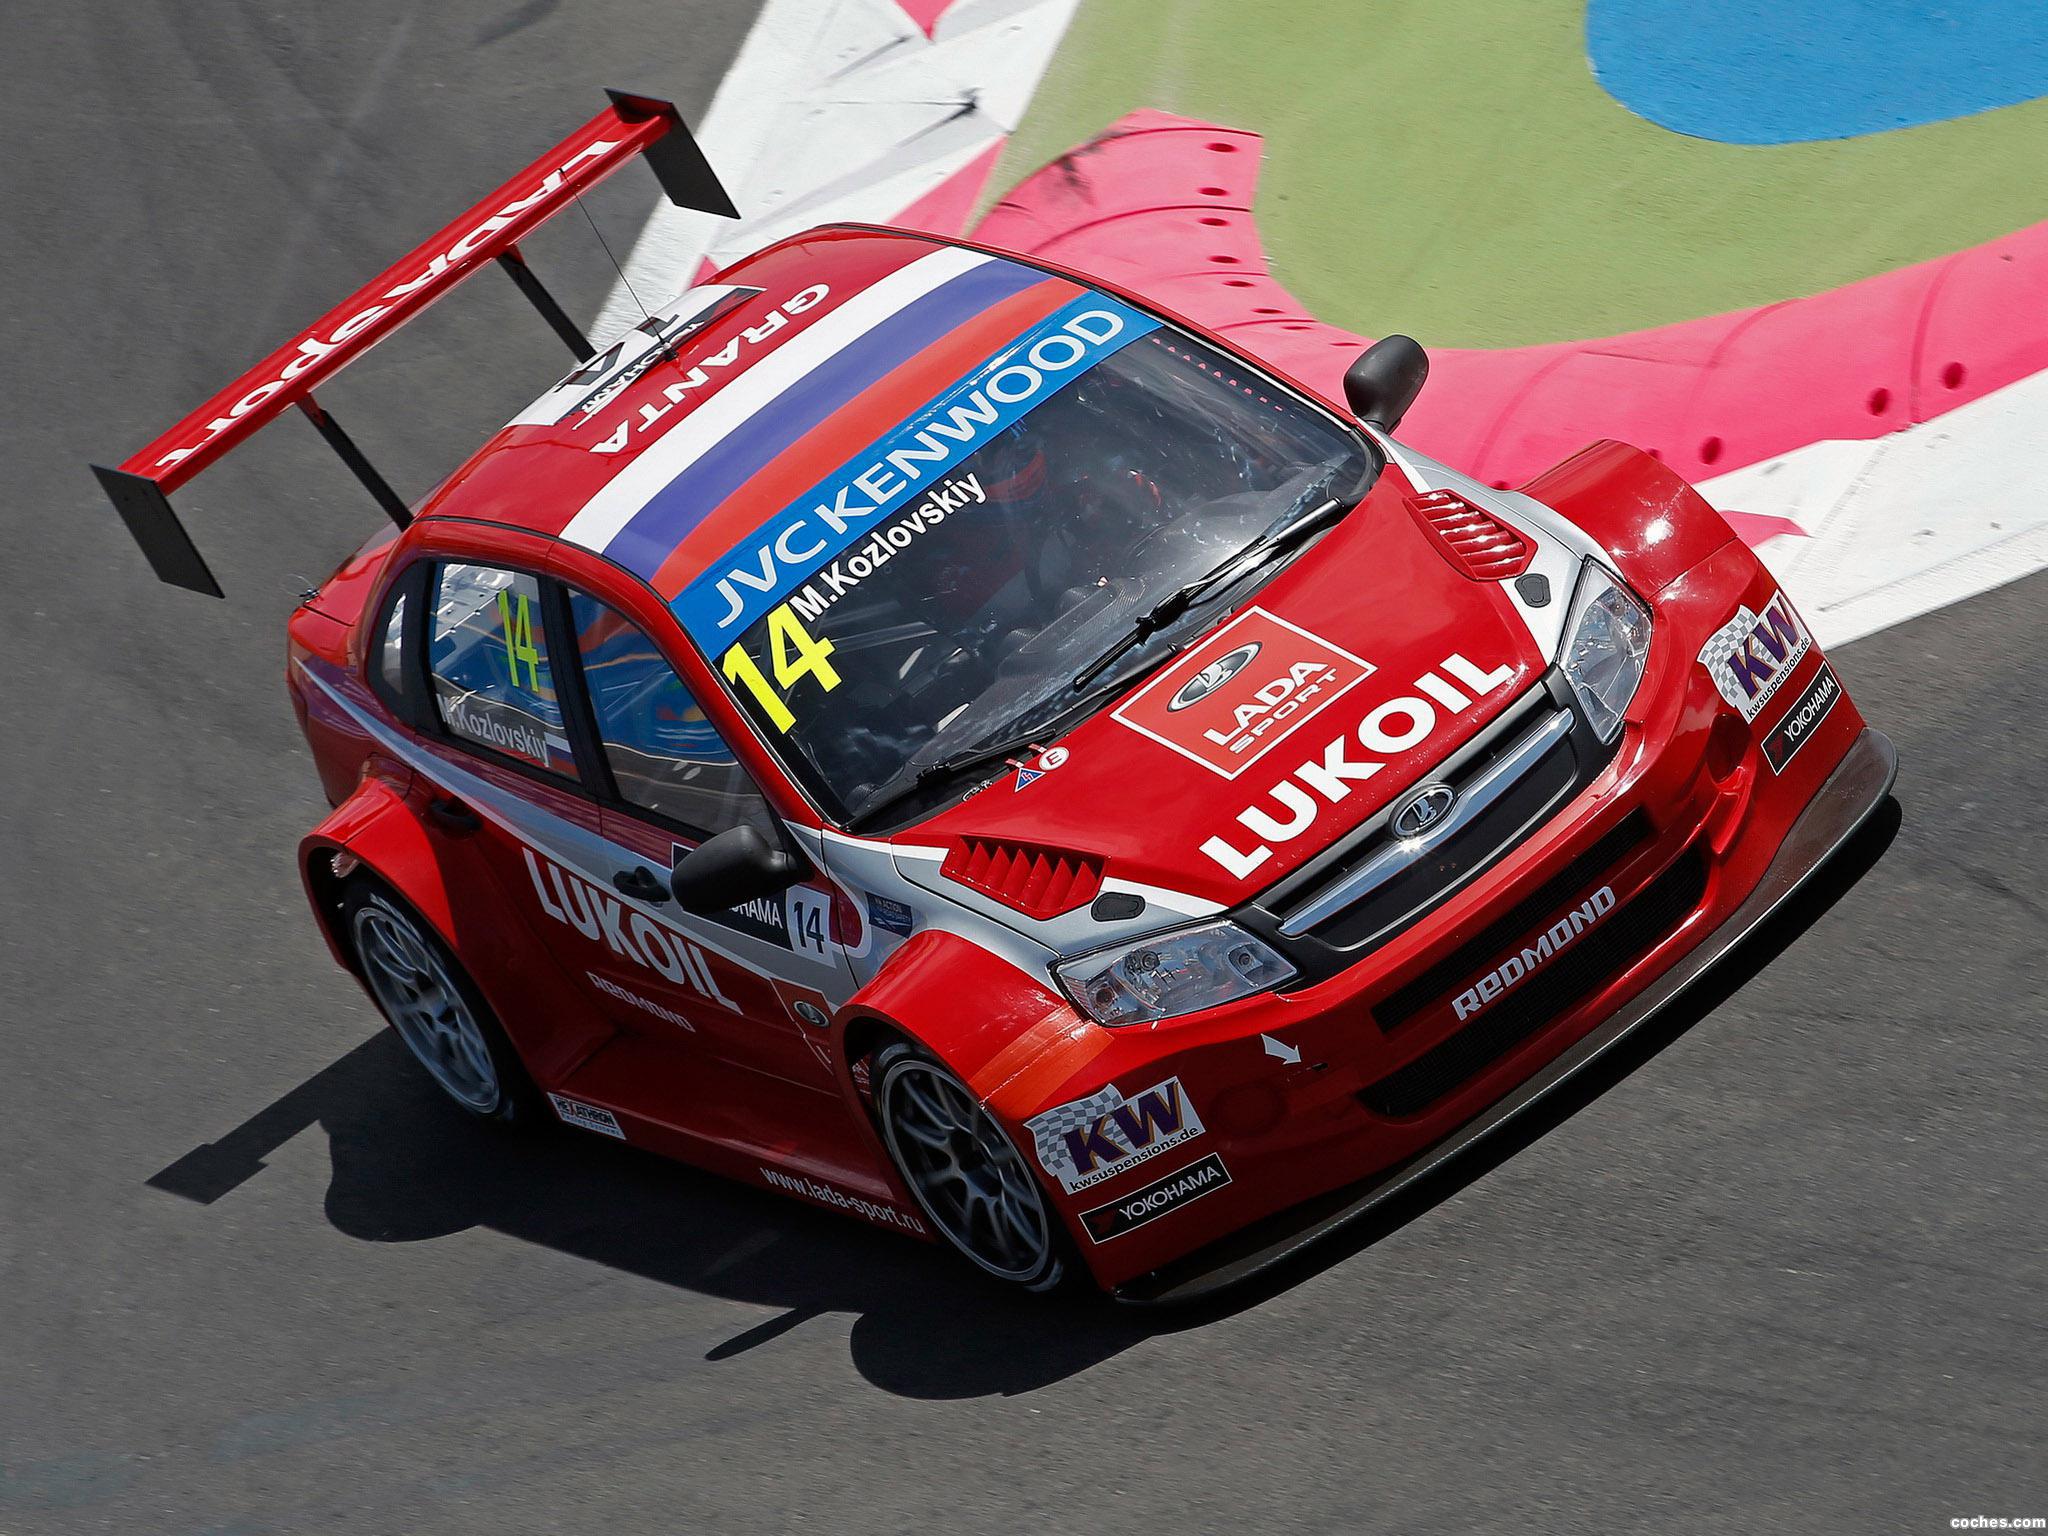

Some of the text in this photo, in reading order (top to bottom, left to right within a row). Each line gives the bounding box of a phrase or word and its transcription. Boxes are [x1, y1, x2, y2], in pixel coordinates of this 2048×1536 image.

[589, 283, 831, 453] GRANTA
[788, 471, 988, 623] M.Kozlovskiy
[497, 588, 539, 693] 14
[722, 602, 843, 735] 14
[1727, 594, 1801, 700] KW
[1745, 636, 1810, 719] kwsuspensions.de
[1202, 661, 1329, 746] LADA
[1229, 667, 1337, 754] SPORT
[1783, 675, 1836, 742] YOKOHAMA
[1198, 651, 1516, 881] LUKOIL
[522, 847, 744, 1016] LUKOIL
[793, 901, 825, 954] 14
[1062, 1080, 1184, 1176] KW
[1069, 1126, 1199, 1191] kwsuspensions.de
[759, 1166, 926, 1234] www.lada-sport.ru
[1119, 1166, 1222, 1220] YOKOHAMA
